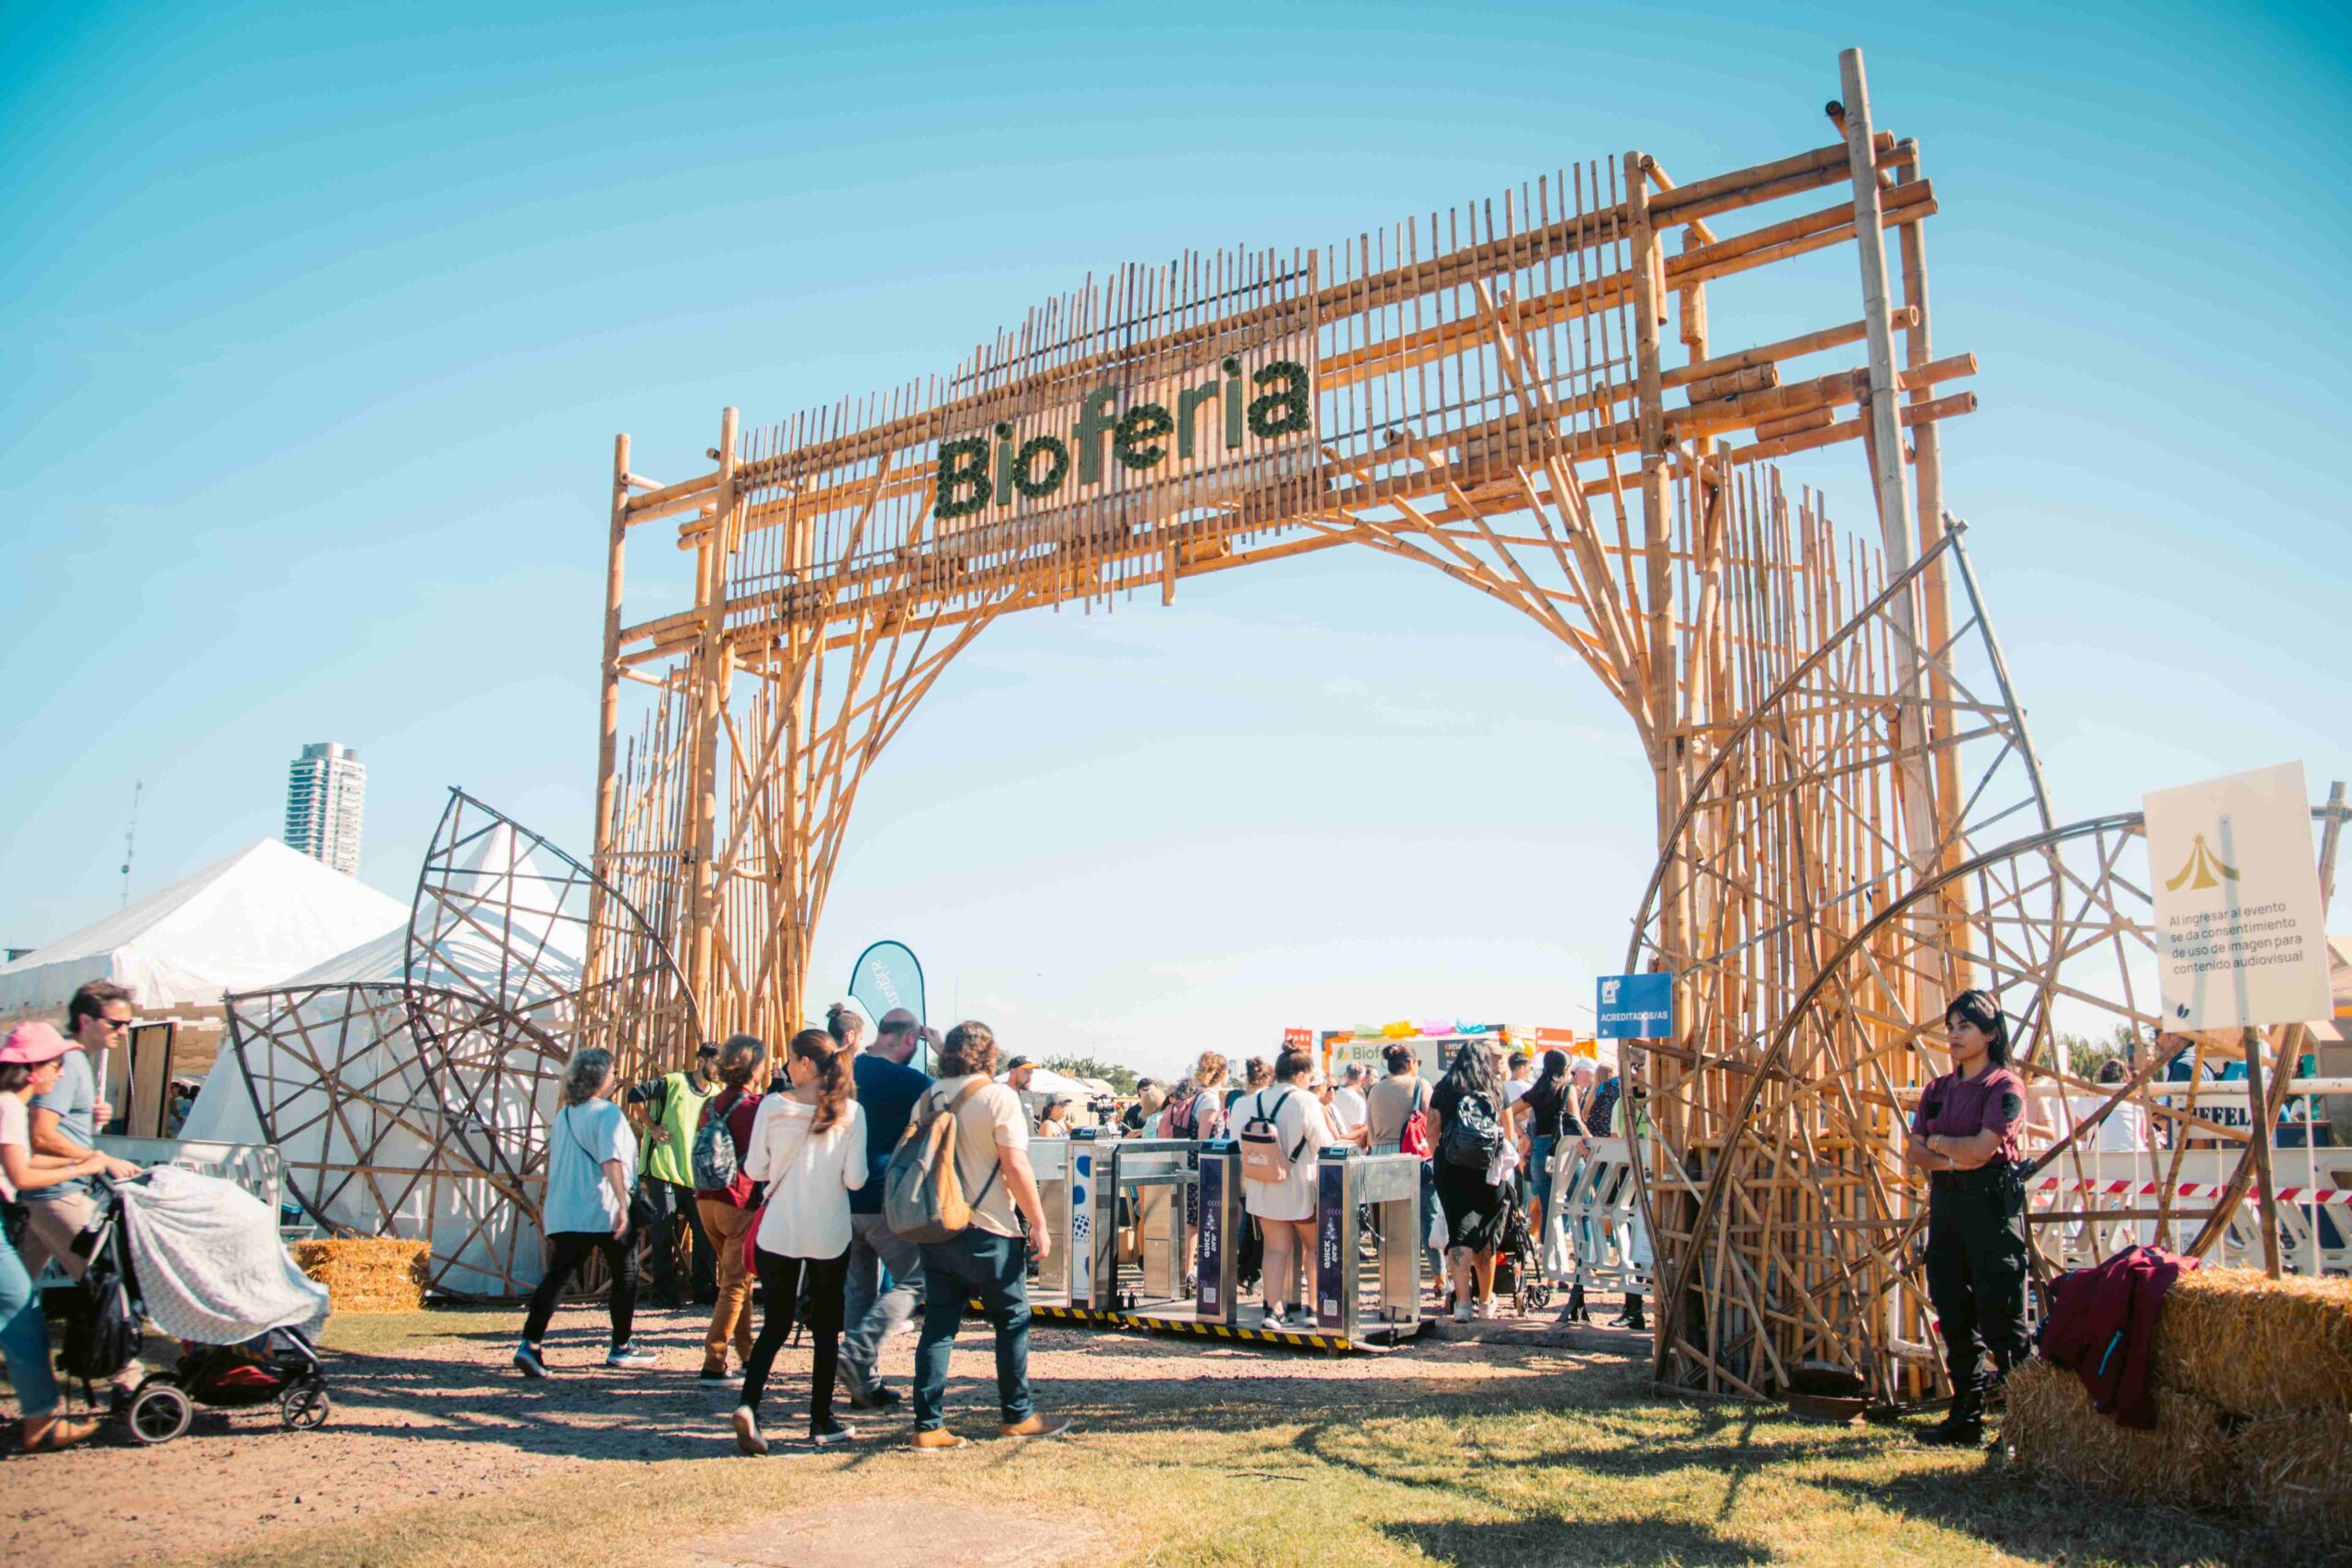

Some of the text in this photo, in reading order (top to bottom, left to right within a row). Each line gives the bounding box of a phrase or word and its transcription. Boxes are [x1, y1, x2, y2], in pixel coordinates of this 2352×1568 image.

[933, 356, 1310, 519] Bioferia
[2169, 902, 2286, 927] Al ingresar al evento
[2170, 918, 2296, 943] se da consentimiento
[2172, 935, 2302, 959] de uso de imagen para
[2174, 949, 2303, 975] contenido audiovisual
[1600, 1011, 1668, 1022] ACREDITADOS/AS
[1351, 1044, 1382, 1060] Biof
